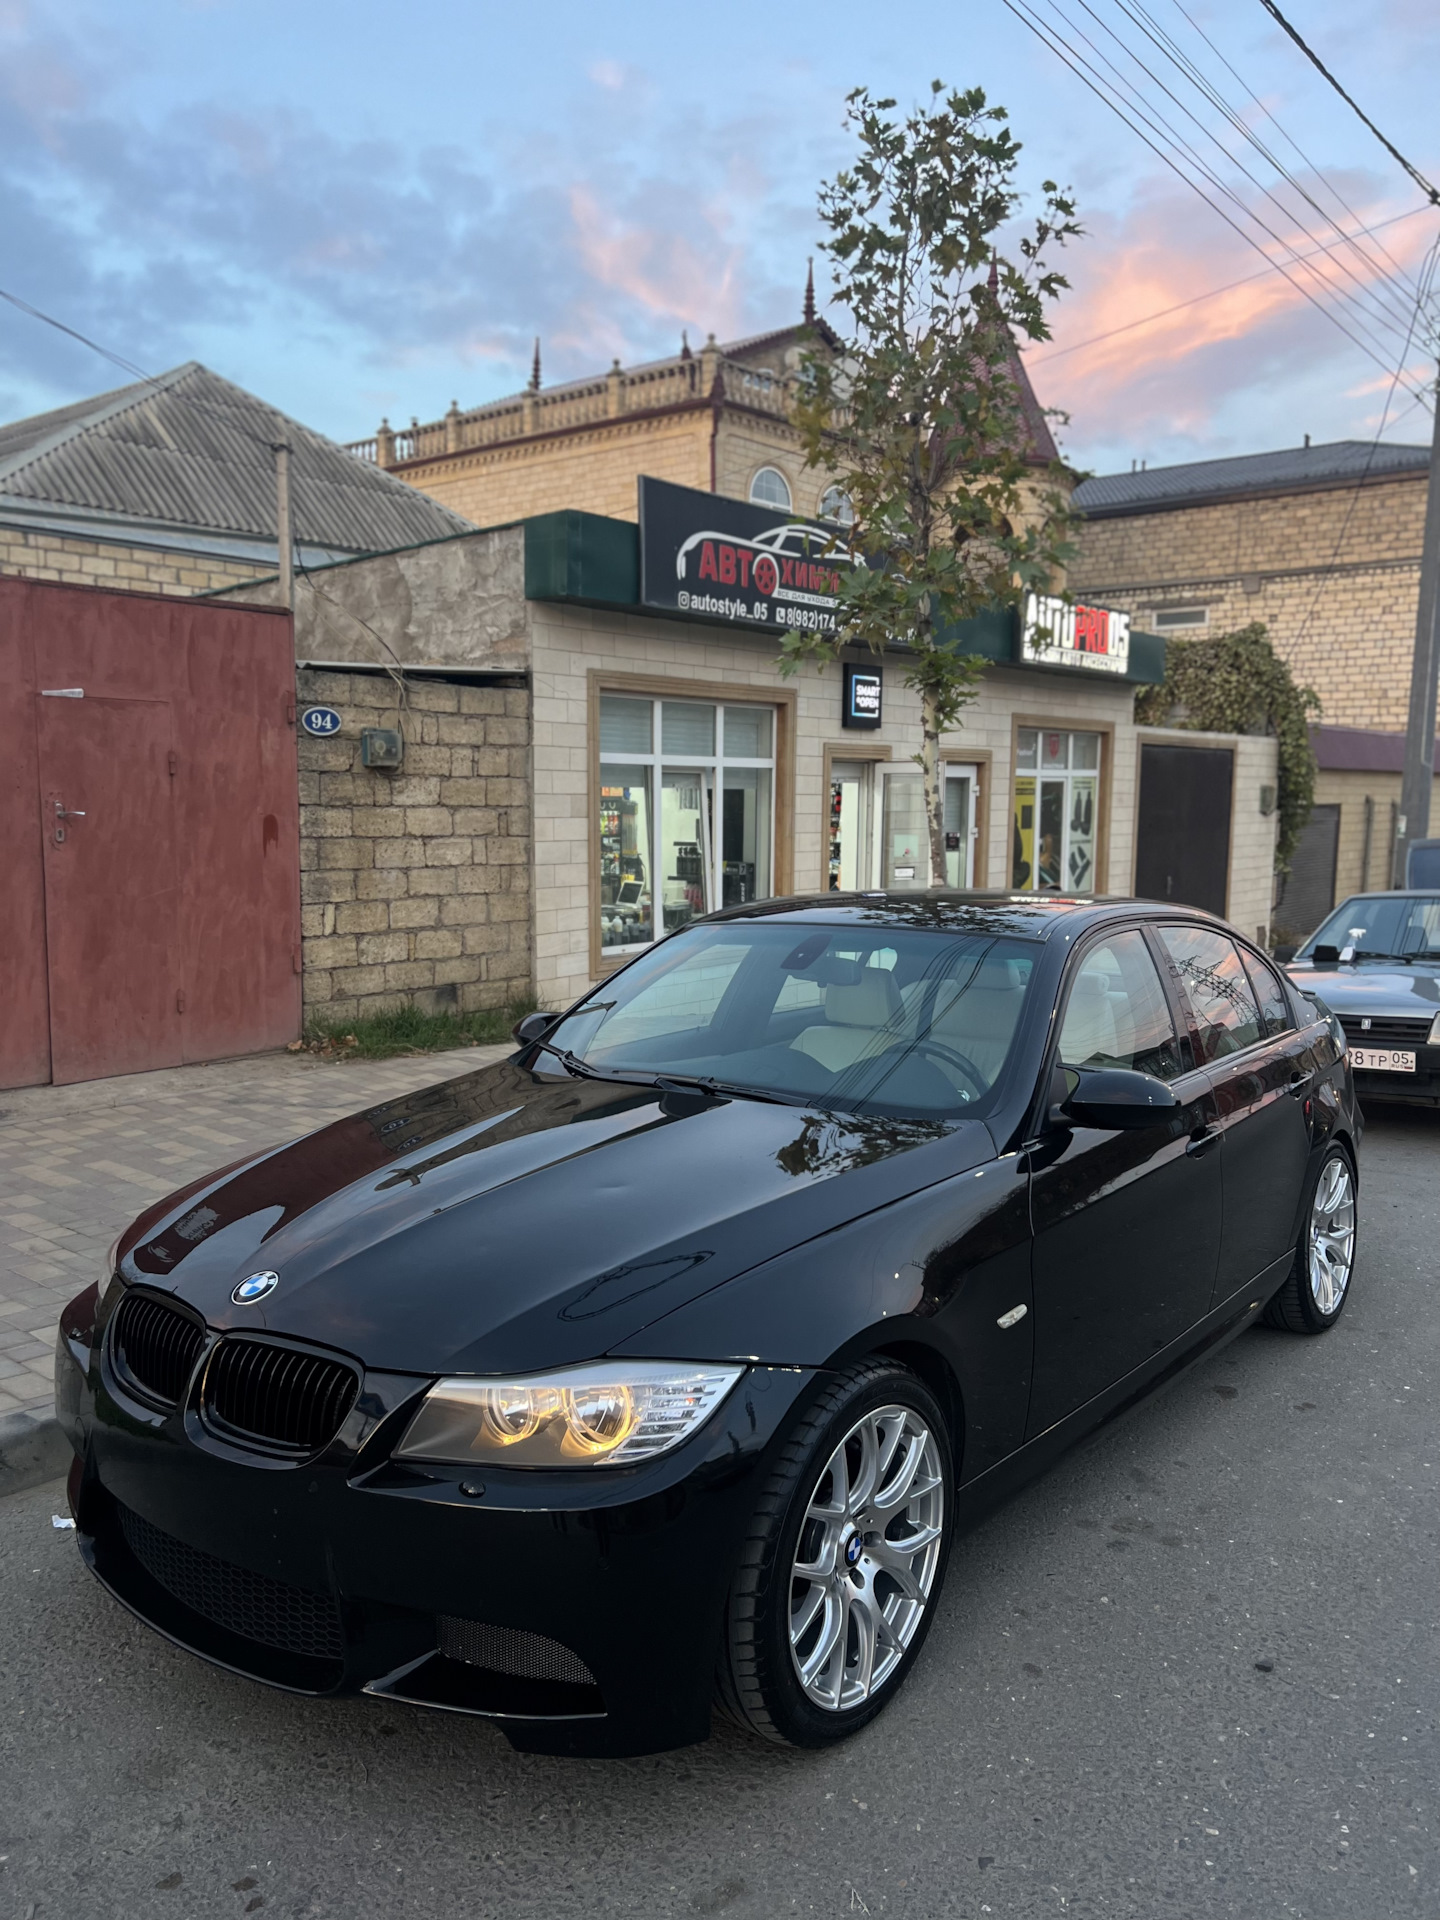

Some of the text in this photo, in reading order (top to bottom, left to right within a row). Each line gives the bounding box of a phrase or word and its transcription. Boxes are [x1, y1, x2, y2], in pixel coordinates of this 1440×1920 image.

[777, 590, 790, 599] ВСЕ
[791, 592, 806, 601] ДЛЯ
[807, 595, 830, 605] УХОДА
[690, 593, 768, 620] autostyle_05
[856, 684, 881, 697] SMART
[311, 713, 332, 729] 94
[1392, 1052, 1409, 1064] 05
